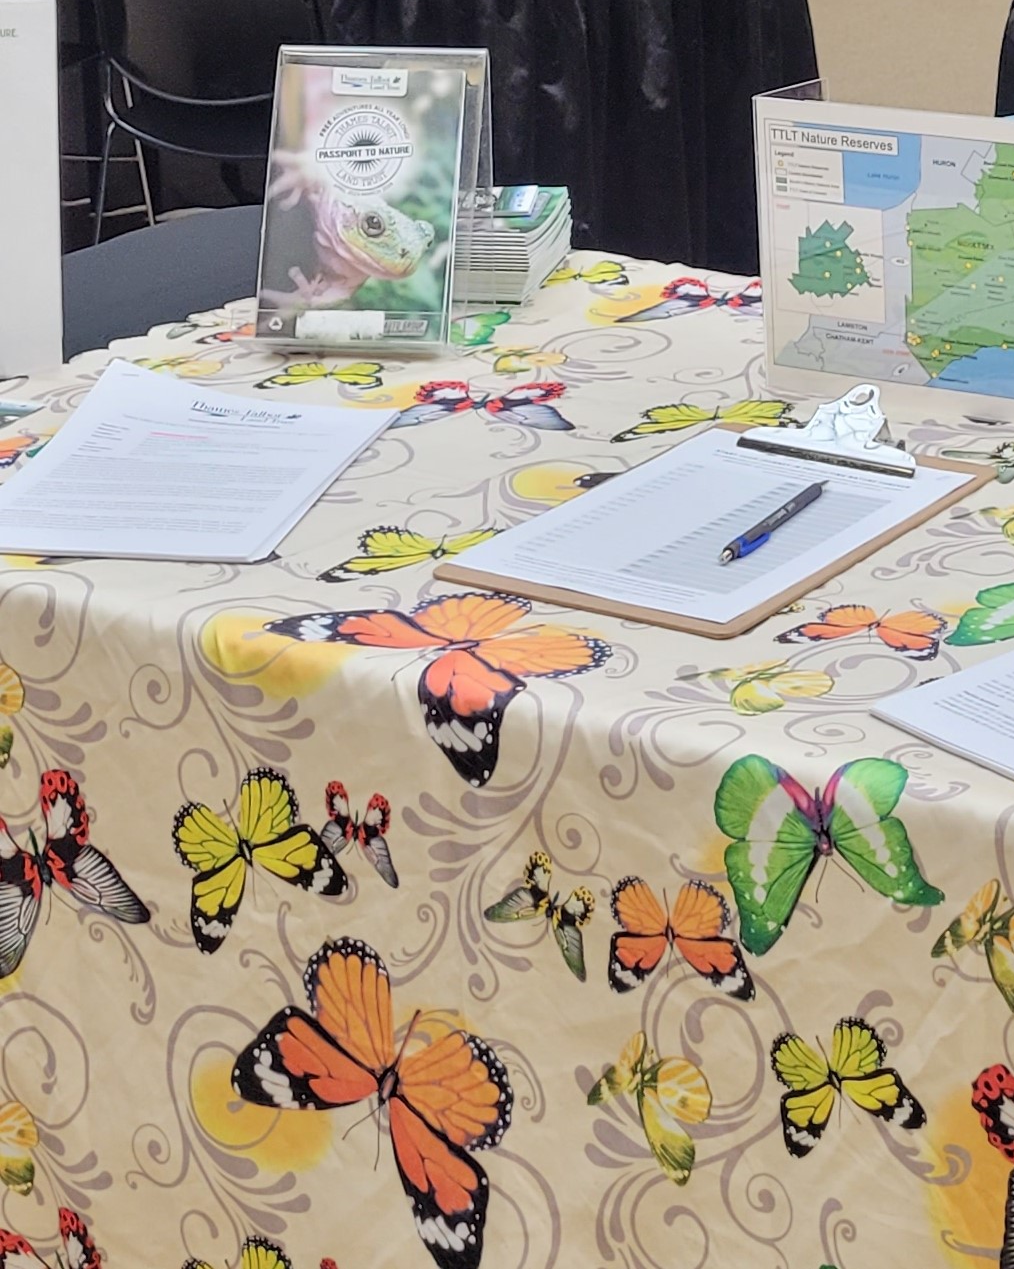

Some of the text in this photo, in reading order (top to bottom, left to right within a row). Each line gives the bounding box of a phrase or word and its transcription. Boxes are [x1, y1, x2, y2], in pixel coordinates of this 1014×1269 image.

[334, 115, 368, 136] THAMES
[771, 128, 893, 151] TTLT Nature Reserves
[319, 145, 409, 159] PASSPORT TO NATURE
[932, 159, 957, 168] HURON
[336, 169, 388, 187] LAND TRUST
